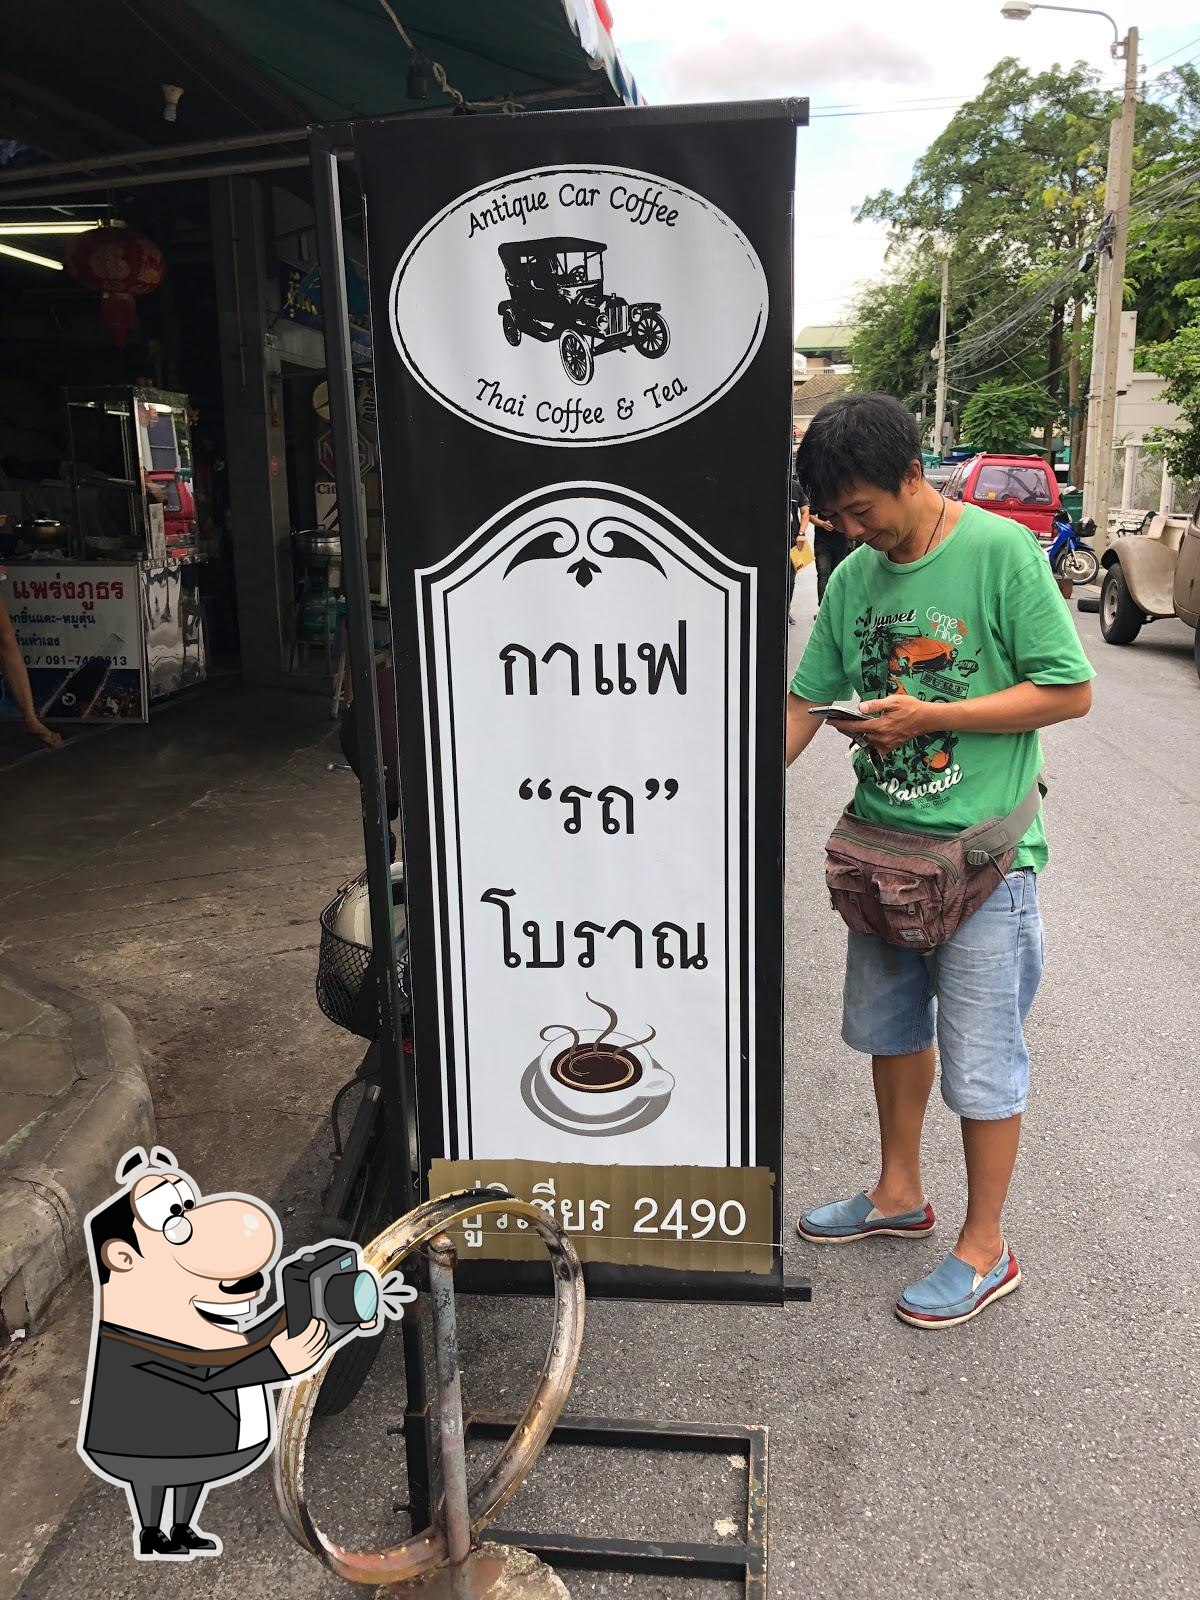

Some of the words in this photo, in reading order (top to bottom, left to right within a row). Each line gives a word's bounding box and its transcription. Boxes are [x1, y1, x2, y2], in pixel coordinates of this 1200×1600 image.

[468, 190, 550, 239] Antique
[558, 183, 600, 208] Car
[609, 186, 680, 227] Coffee
[476, 378, 527, 418] Thai
[536, 398, 605, 434] Coffee
[617, 398, 634, 420] &
[644, 377, 688, 409] Tea
[13, 573, 124, 611] แพร่งภูธร
[926, 606, 958, 631] Come
[934, 624, 963, 645] Alive
[499, 620, 687, 696] กาแฟ
[480, 887, 709, 969] โบราณ
[633, 1197, 747, 1240] 2490
